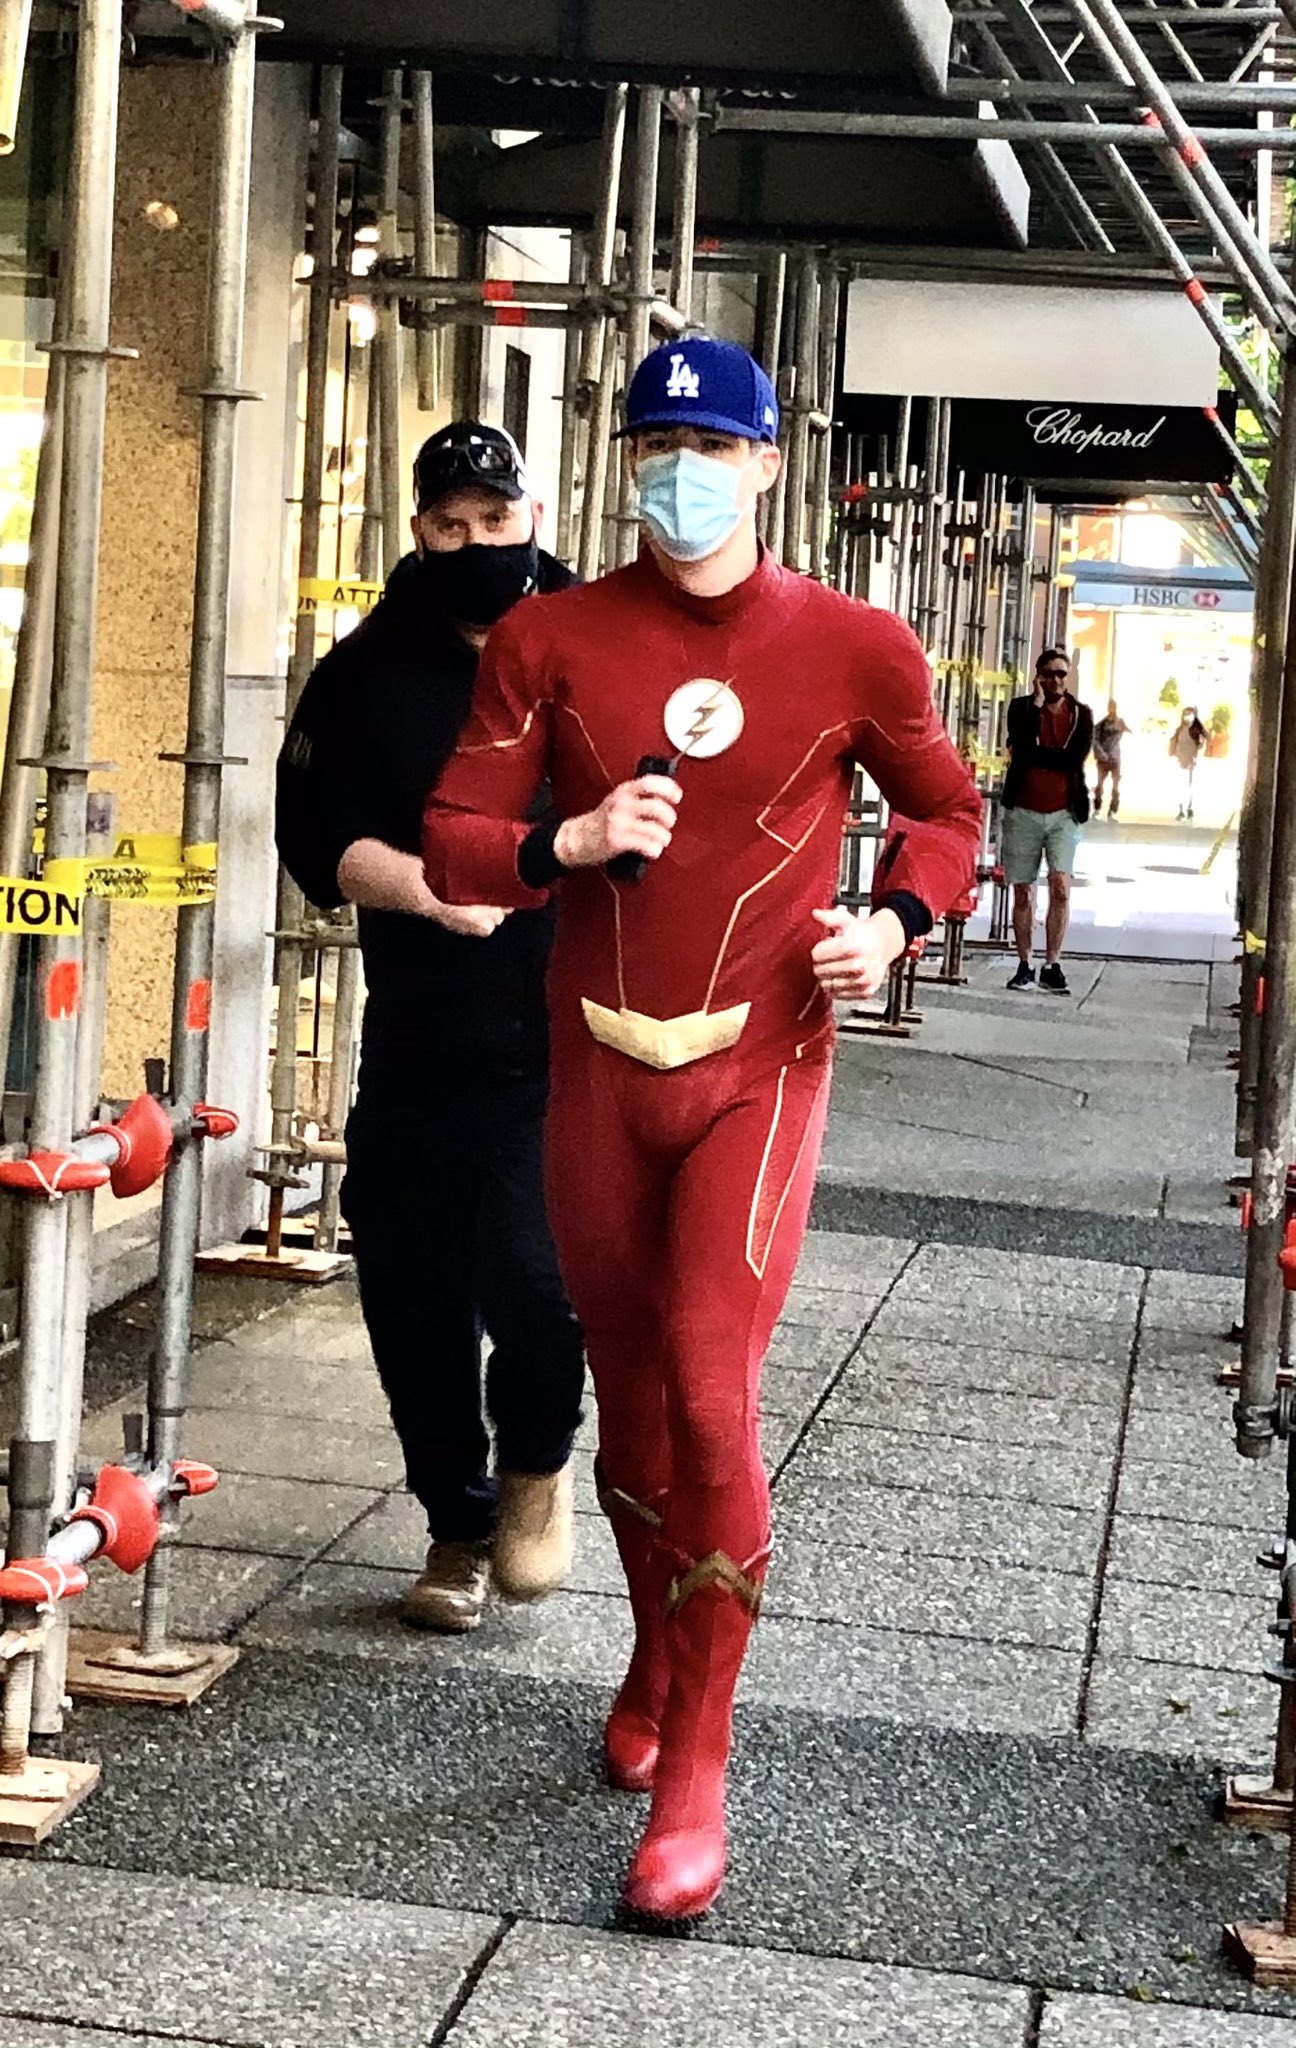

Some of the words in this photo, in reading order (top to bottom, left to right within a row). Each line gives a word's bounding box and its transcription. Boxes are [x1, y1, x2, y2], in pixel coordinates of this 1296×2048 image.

[666, 353, 700, 398] LA
[1025, 406, 1167, 454] Chopard
[1133, 587, 1190, 607] HSBC
[0, 885, 80, 926] ION
